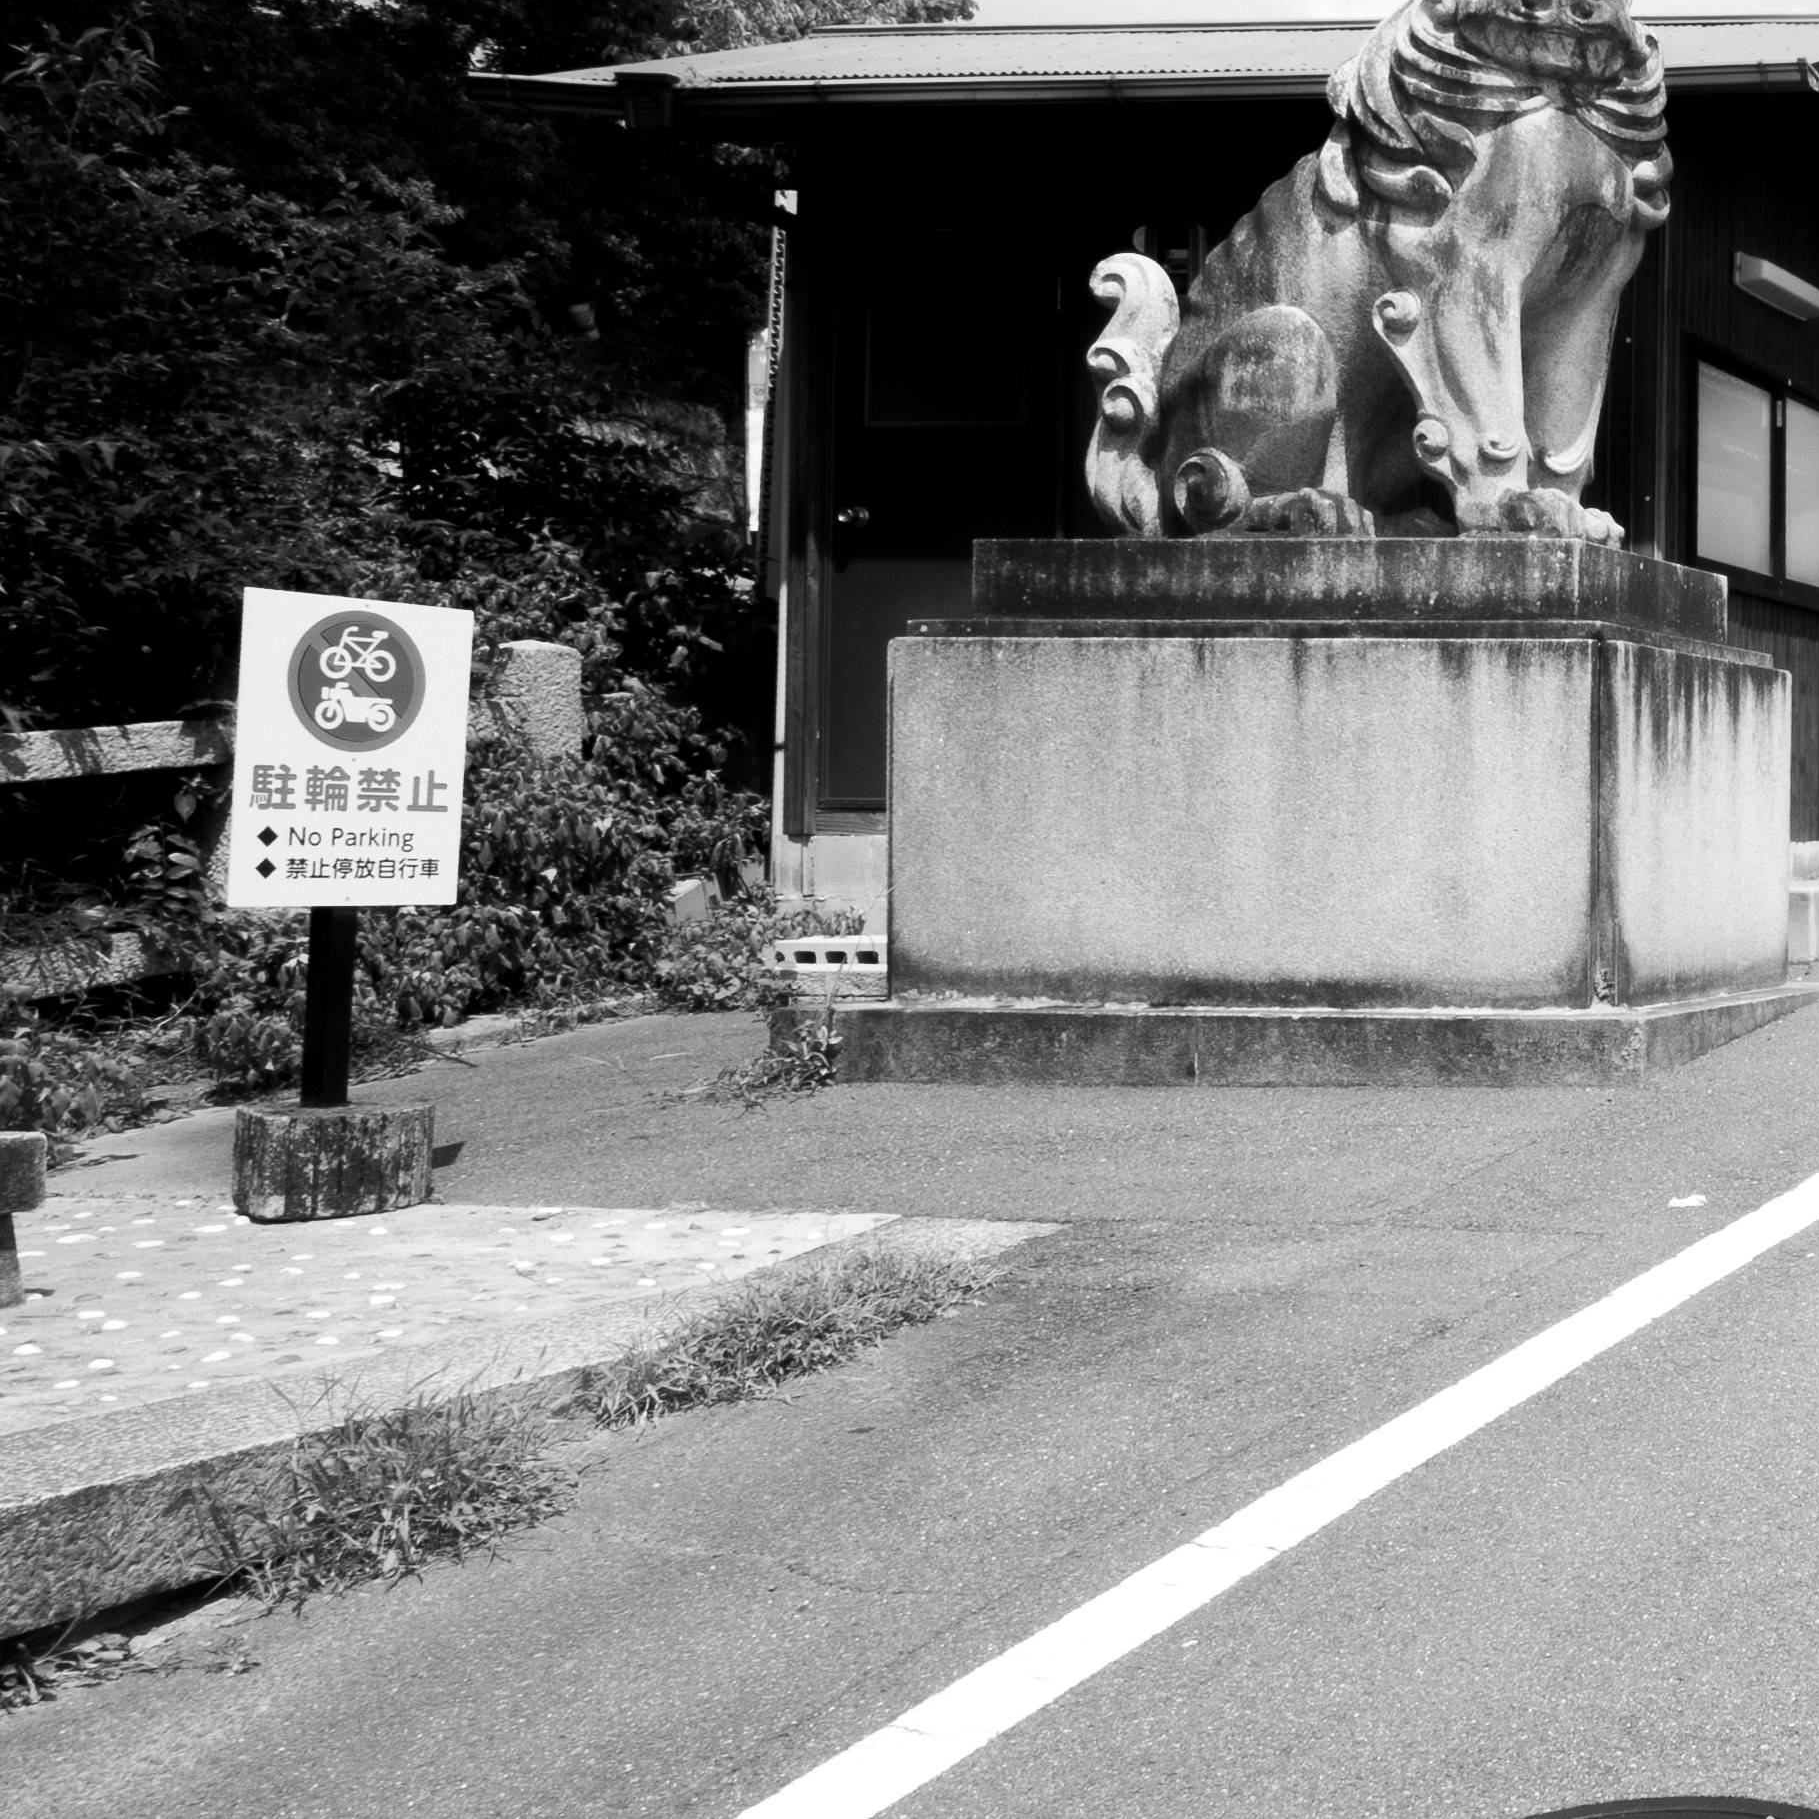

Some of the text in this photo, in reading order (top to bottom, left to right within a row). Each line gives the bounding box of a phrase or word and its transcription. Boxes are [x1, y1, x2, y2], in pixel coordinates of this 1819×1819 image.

[249, 764, 449, 813] 駐輪禁止
[288, 826, 415, 853] No Parking
[286, 857, 440, 879] 禁止停放自行車
